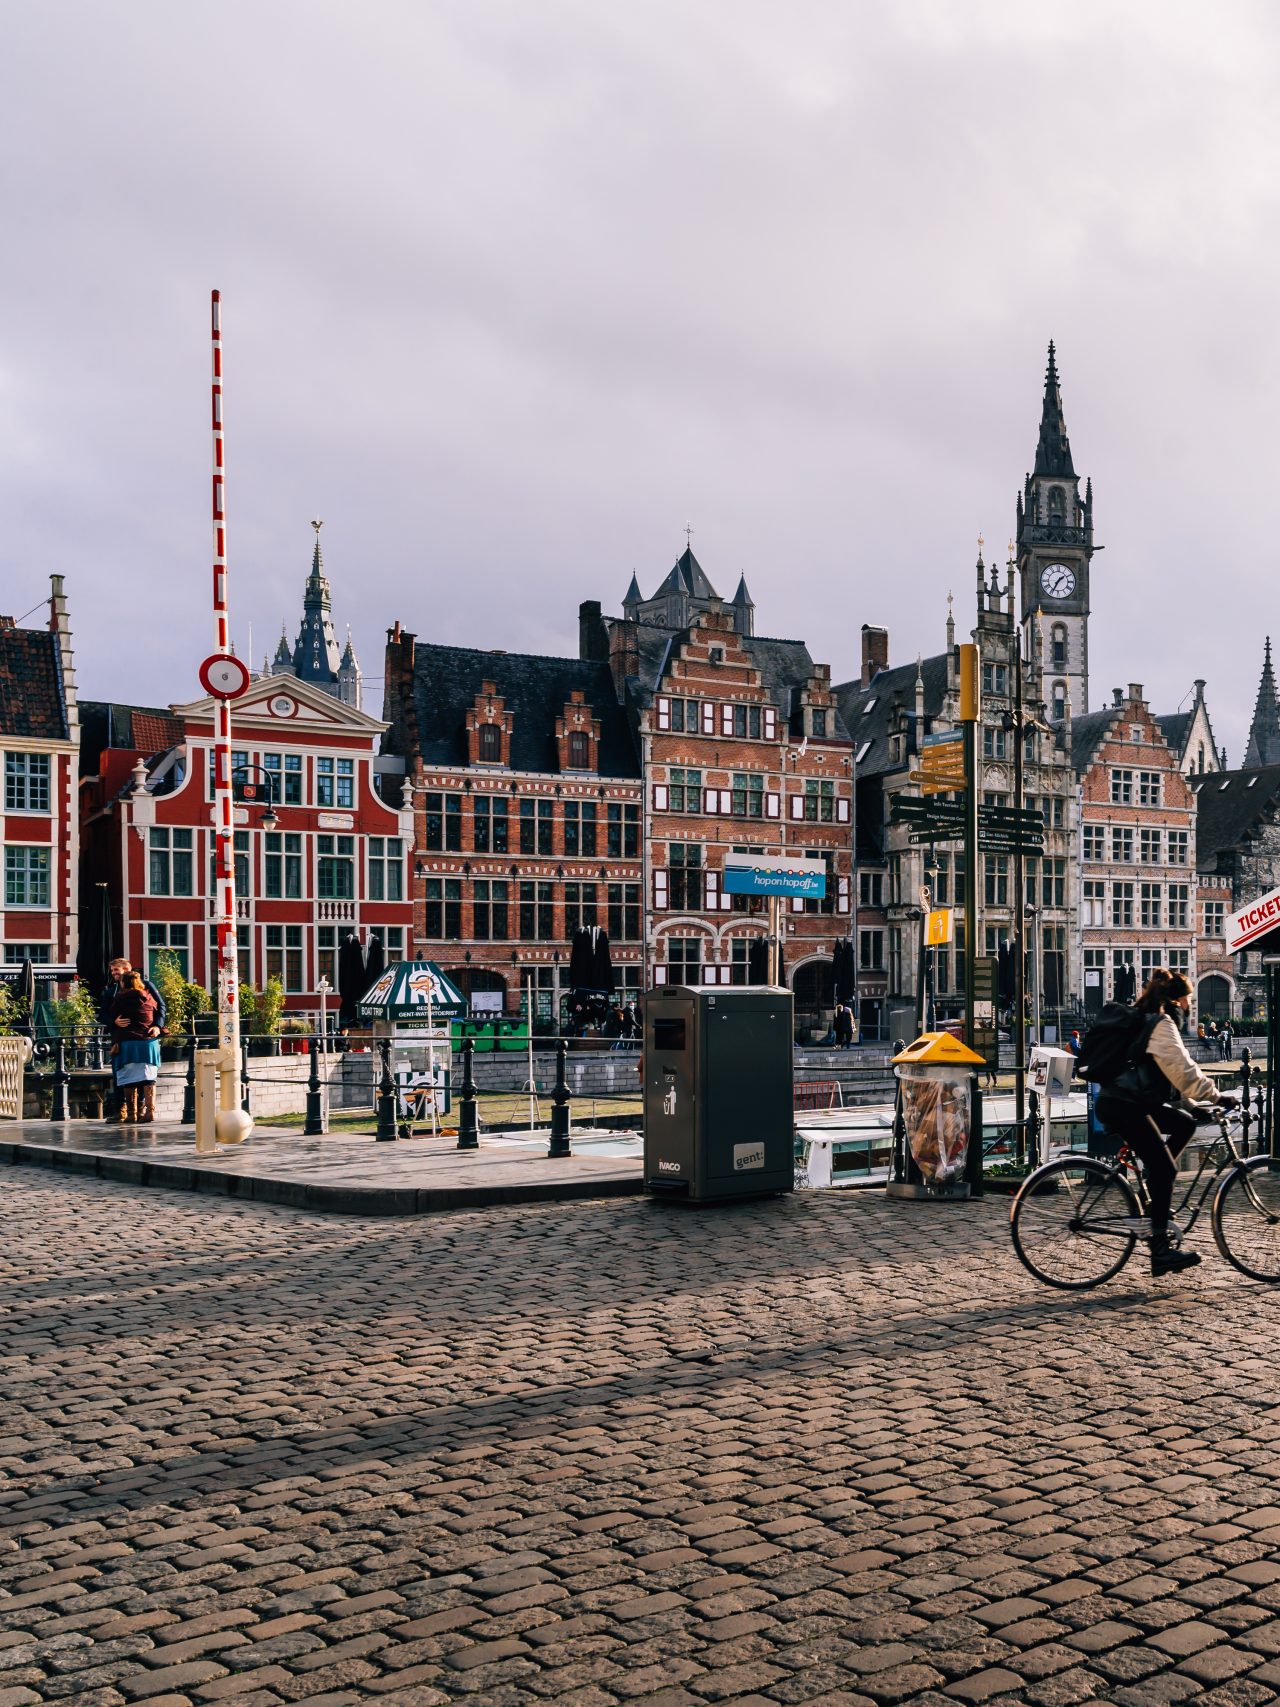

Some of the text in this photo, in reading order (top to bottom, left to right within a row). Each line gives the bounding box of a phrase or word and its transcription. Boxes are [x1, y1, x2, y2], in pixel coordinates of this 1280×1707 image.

[361, 1006, 384, 1016] BOAT TRIP
[398, 1010, 458, 1018] GENT-WATRTOERIST
[736, 1151, 764, 1168] gent:
